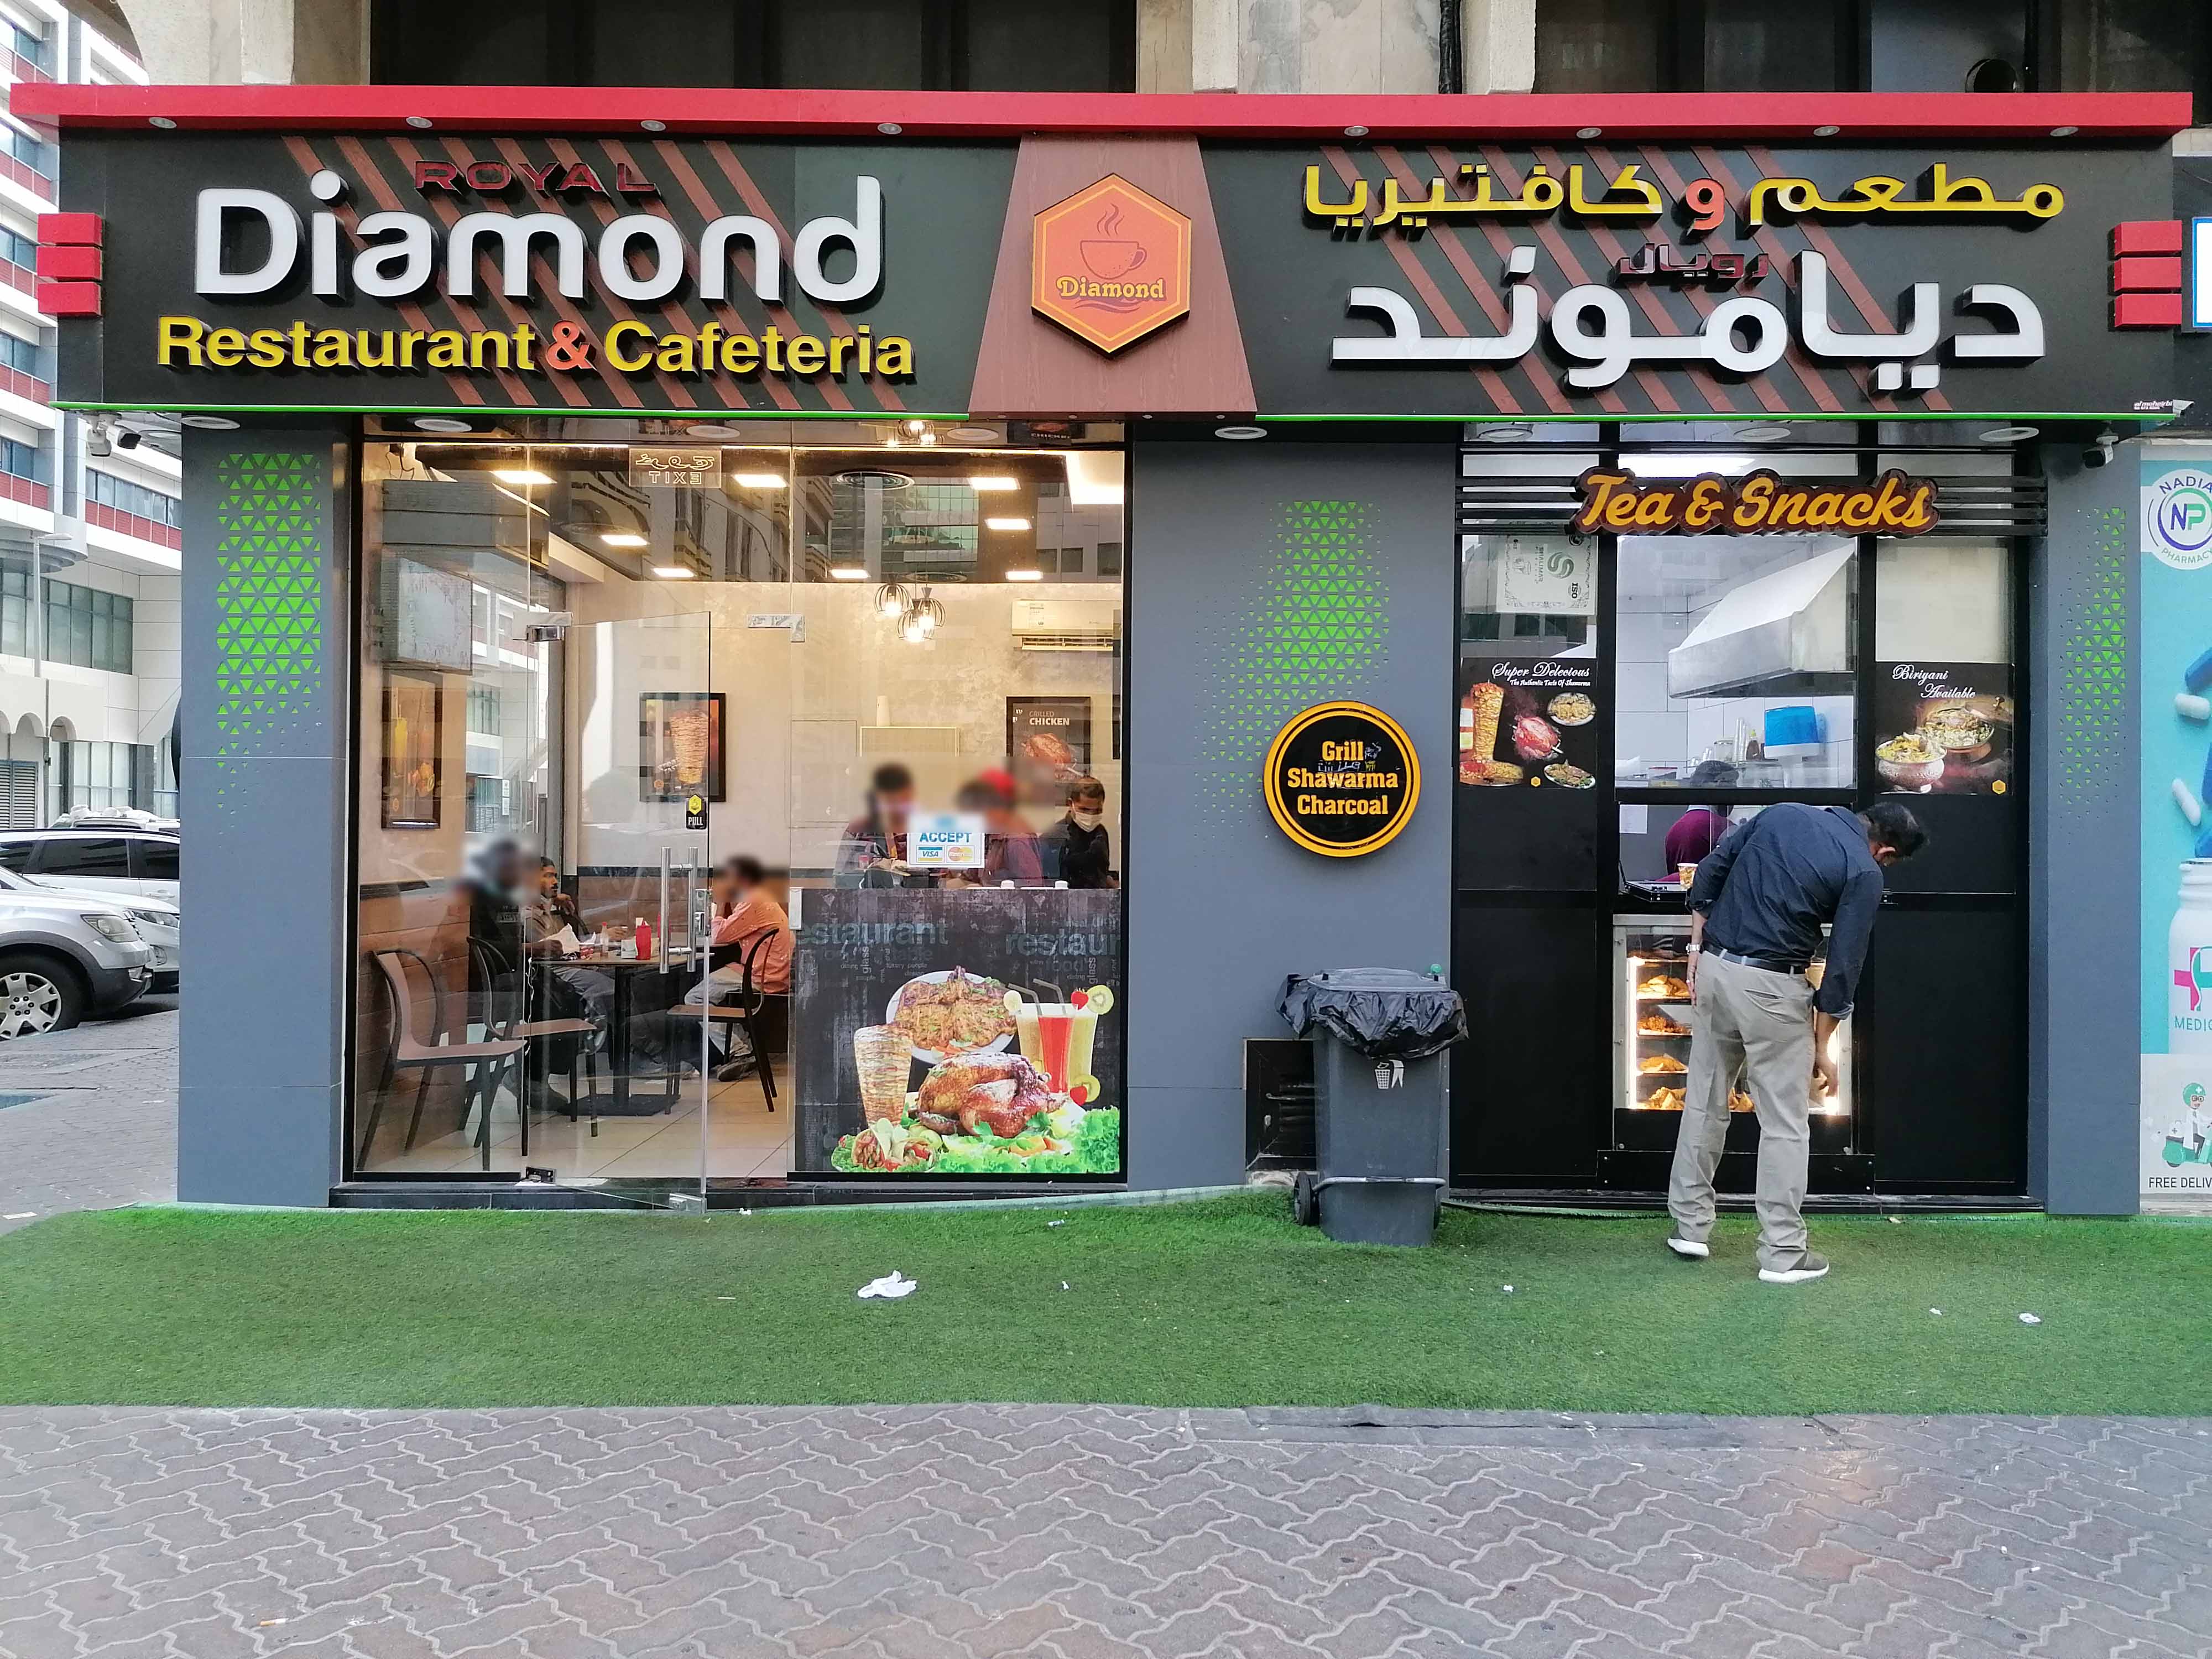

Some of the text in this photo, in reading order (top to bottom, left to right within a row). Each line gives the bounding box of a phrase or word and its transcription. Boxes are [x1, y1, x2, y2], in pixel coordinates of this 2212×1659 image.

[415, 160, 658, 193] ROYAL
[1304, 162, 2065, 231] مطعم و كافتيريا
[196, 169, 880, 302] Diamond
[1620, 243, 1768, 278] رويال
[1056, 276, 1165, 300] Diamond
[1332, 244, 2045, 390] دياموند
[158, 315, 914, 375] Restaurant & Cafeteria
[2159, 476, 2212, 494] NADIA
[1582, 474, 1932, 528] Tea & Snacks
[2170, 503, 2206, 531] NP
[1492, 661, 1590, 681] Super Delecious
[1892, 664, 1949, 686] Biriyani
[1557, 679, 1565, 688] Of
[1921, 683, 1976, 698] Available
[1029, 717, 1070, 726] CHICKEN
[1322, 740, 1364, 761] Grill
[1287, 768, 1398, 788] Shawarma
[1297, 795, 1389, 815] Charcoal
[688, 817, 704, 826] PULL
[920, 832, 972, 843] ACCEPT
[860, 946, 872, 974] glass
[1087, 957, 1098, 984] glass
[2148, 1177, 2212, 1188] FREE DELIV
